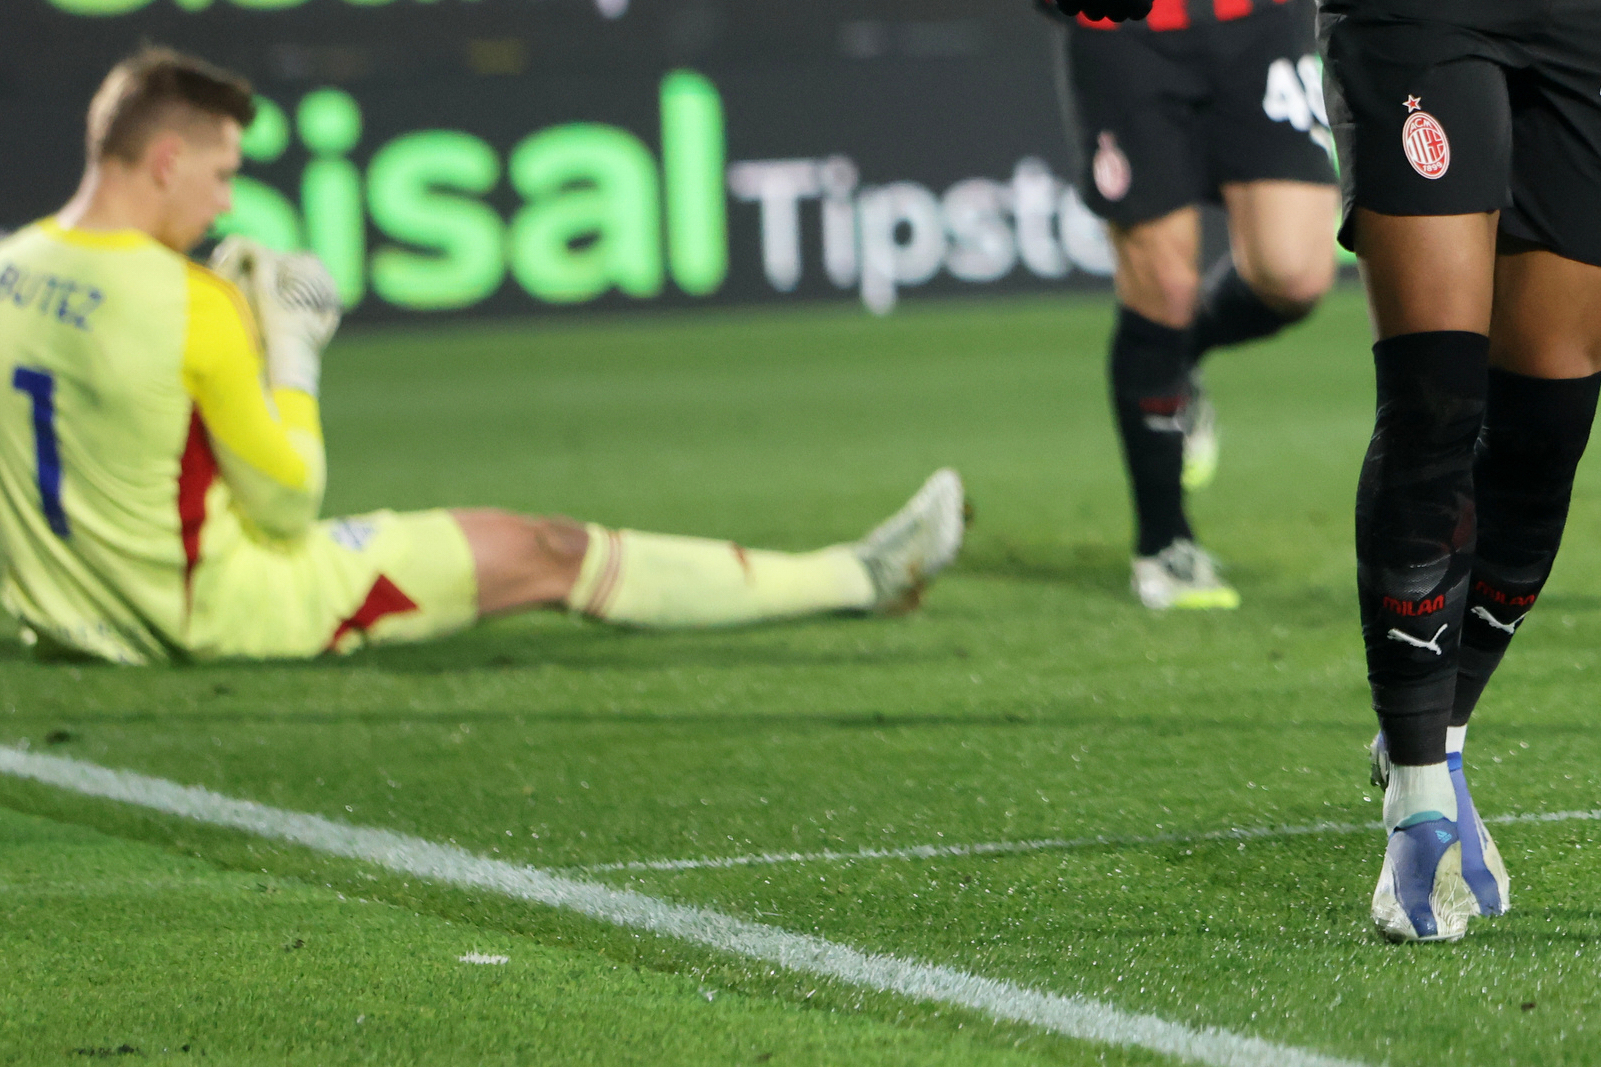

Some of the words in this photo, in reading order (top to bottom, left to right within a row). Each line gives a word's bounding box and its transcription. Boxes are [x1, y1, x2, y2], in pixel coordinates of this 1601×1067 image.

[1410, 117, 1433, 134] ACM
[1422, 161, 1443, 172] 1899
[728, 154, 1118, 318] Tipste
[14, 367, 70, 540] 1
[1382, 593, 1446, 617] MILAN
